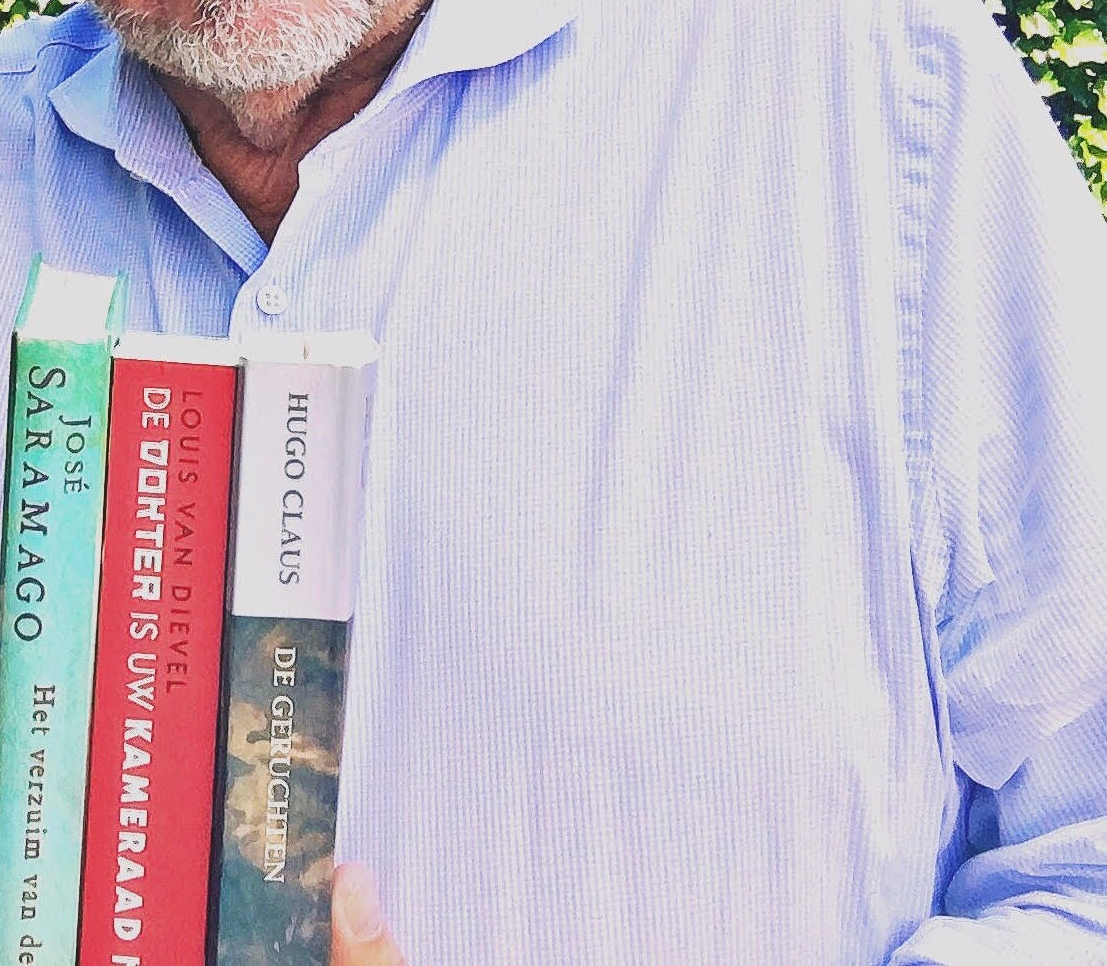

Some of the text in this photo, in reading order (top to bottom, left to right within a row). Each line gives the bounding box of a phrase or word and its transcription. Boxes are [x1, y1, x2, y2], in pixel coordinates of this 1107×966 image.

[13, 365, 66, 642] SARAMAGO
[59, 414, 92, 495] José
[140, 387, 172, 429] DE
[279, 393, 309, 586] HUGO CLAUS
[128, 611, 160, 641] IS
[165, 390, 203, 693] LOUIS VAN DIEVEL
[123, 652, 156, 713] UW
[262, 646, 297, 884] DE GERUCHTEN
[18, 684, 56, 966] Het verzuim van de
[112, 718, 153, 941] KAMERAAD
